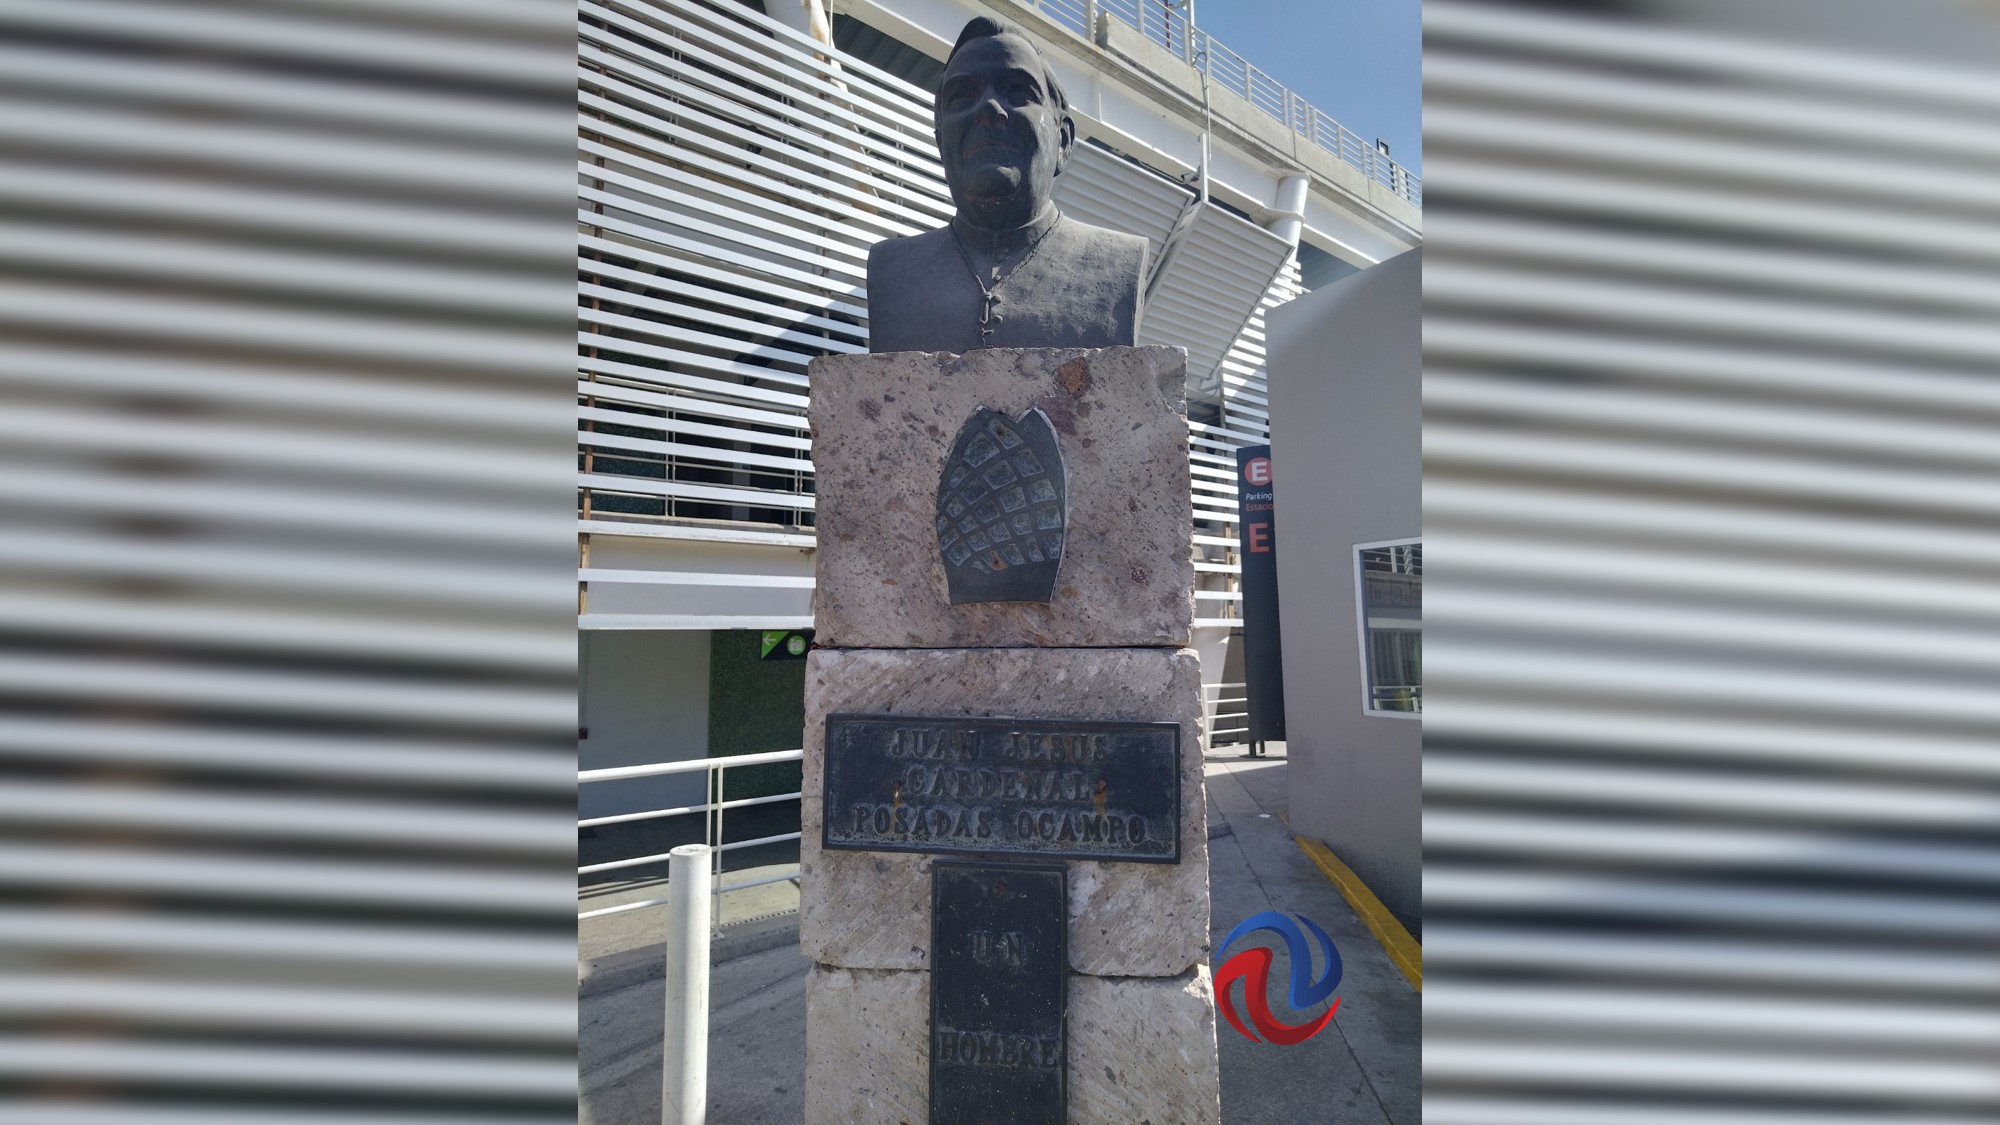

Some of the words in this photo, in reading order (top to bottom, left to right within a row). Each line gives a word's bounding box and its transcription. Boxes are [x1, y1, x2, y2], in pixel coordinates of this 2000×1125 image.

[1251, 461, 1268, 481] E
[1245, 492, 1273, 501] Parking
[1249, 522, 1270, 553] E
[890, 729, 981, 761] JUAN
[1005, 732, 1108, 763] JESUS
[907, 768, 1090, 801] CARDENAL
[854, 806, 993, 839] POSADAS
[1016, 811, 1147, 845] OCAMPO
[972, 930, 1025, 965] UN
[939, 1031, 1061, 1068] HOMBRE
